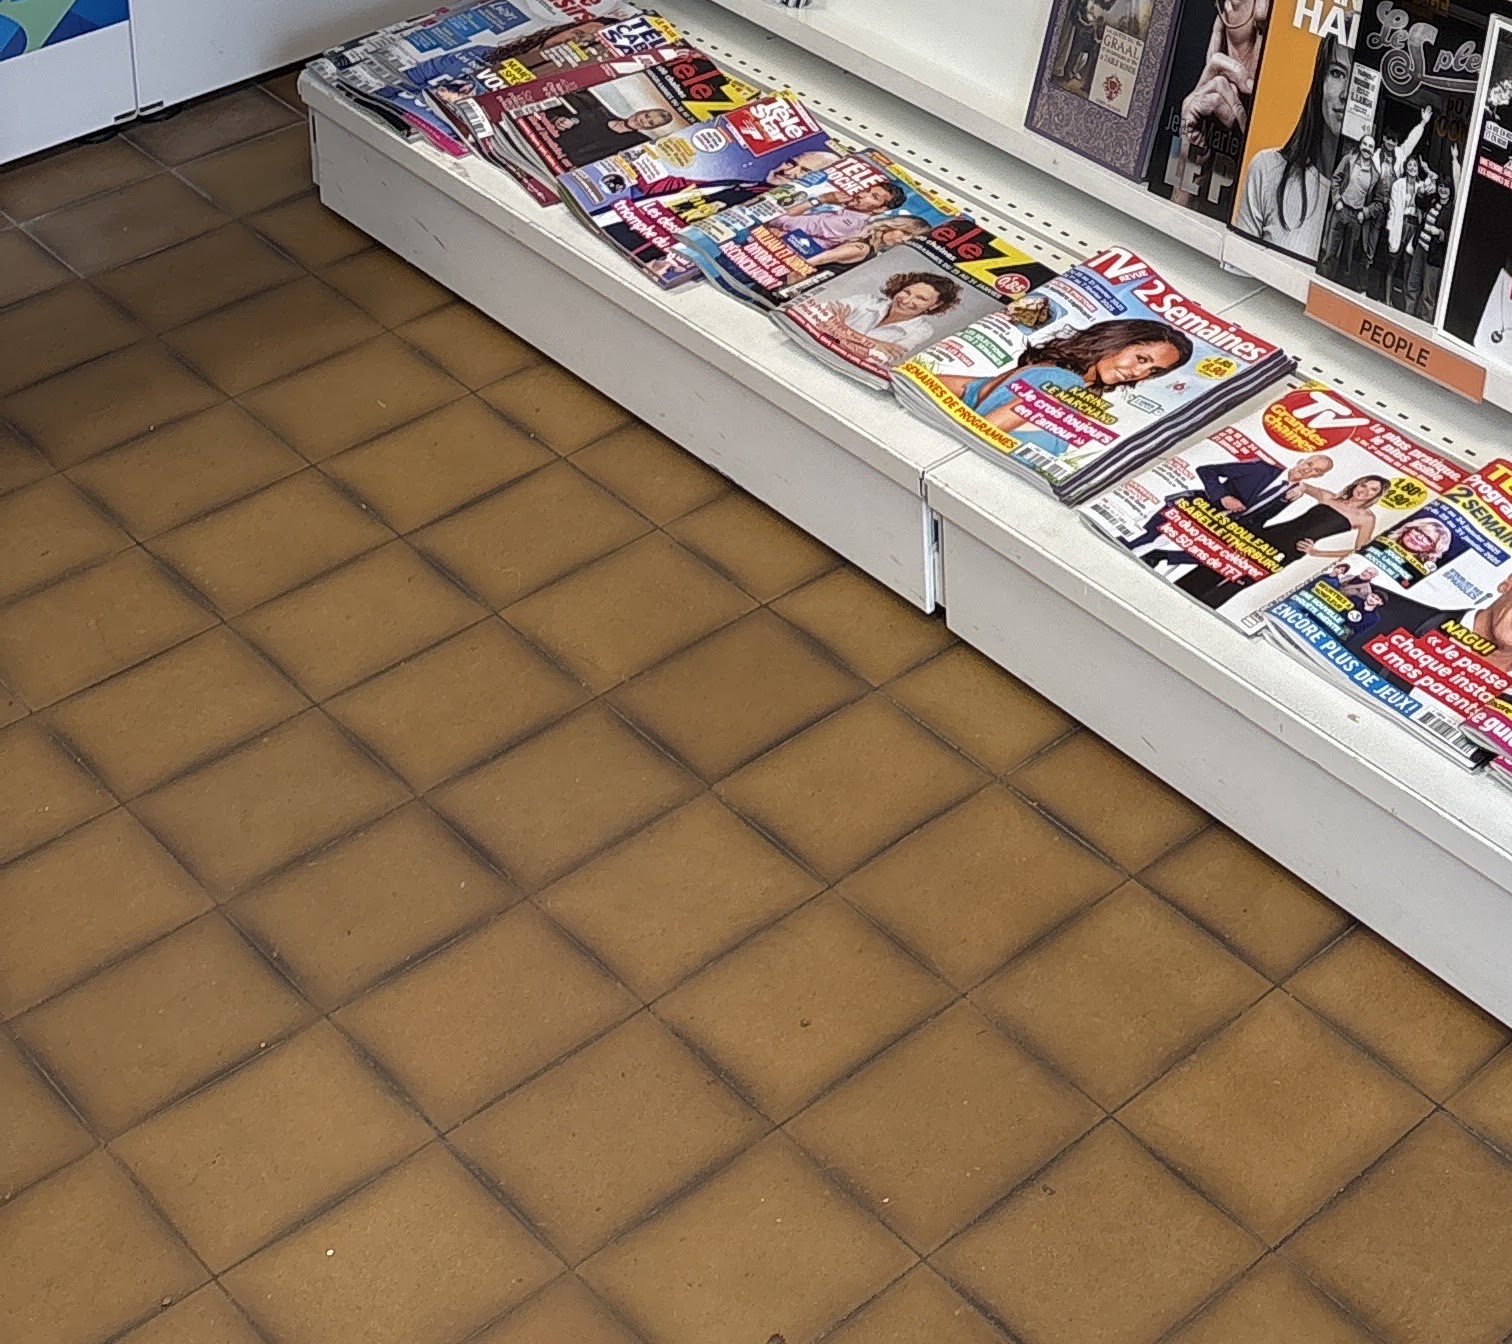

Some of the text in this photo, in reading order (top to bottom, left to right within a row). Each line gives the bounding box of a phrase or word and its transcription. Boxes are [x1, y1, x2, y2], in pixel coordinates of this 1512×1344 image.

[1153, 288, 1269, 365] Semaines
[1358, 319, 1432, 368] PEOPLE
[1439, 620, 1497, 656] NAGUI
